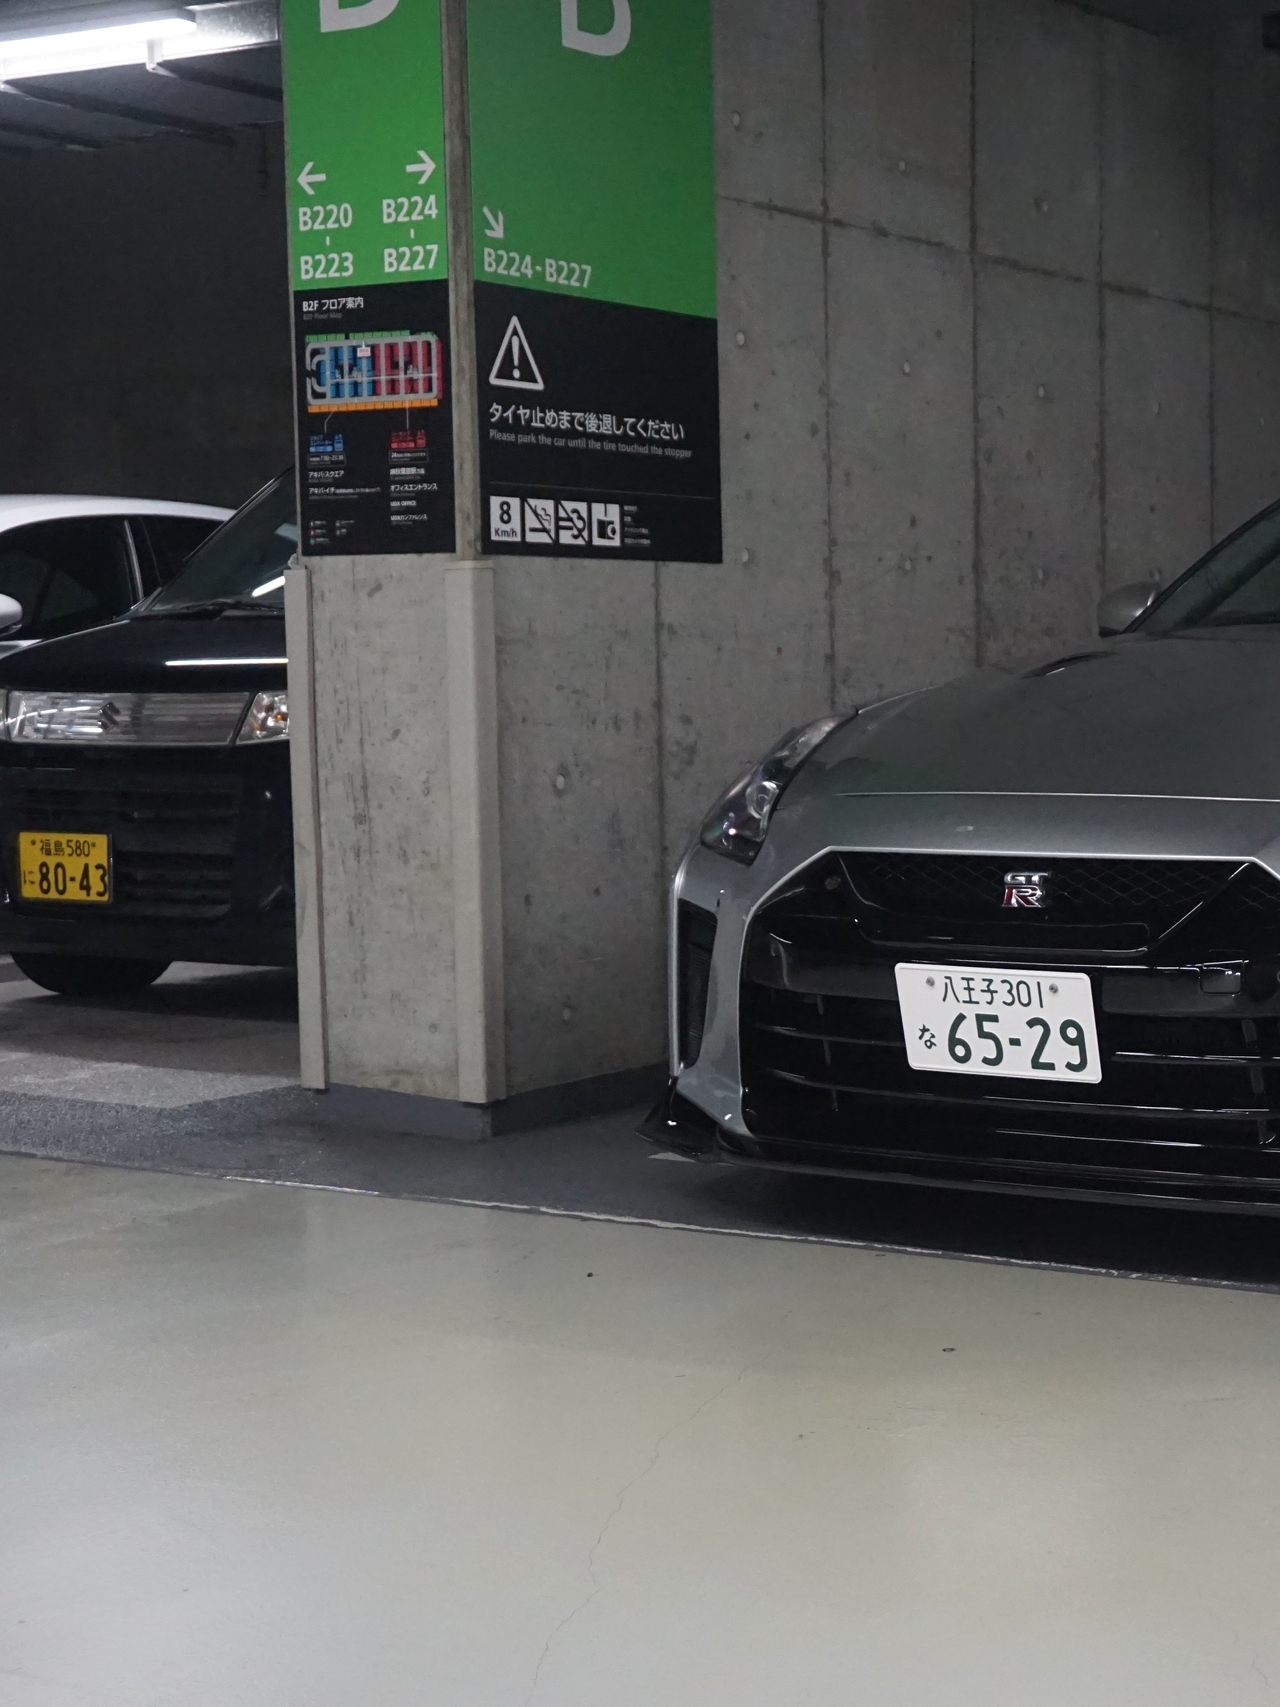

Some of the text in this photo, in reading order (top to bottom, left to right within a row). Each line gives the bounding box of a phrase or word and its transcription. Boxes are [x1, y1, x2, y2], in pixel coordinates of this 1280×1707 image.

[298, 202, 353, 231] B220
[382, 194, 438, 224] B224
[300, 252, 354, 280] B223
[383, 244, 439, 273] B227
[483, 247, 592, 288] B224-B227
[302, 296, 364, 312] B2F フロア案内
[489, 402, 685, 440] タイヤ止めまで後退してください
[489, 429, 692, 459] Please park the car until the tire touched the stopper
[499, 500, 512, 524] 8
[494, 528, 517, 538] Km/h
[23, 861, 107, 897] に 80-43
[918, 1012, 1088, 1073] な 65-29
